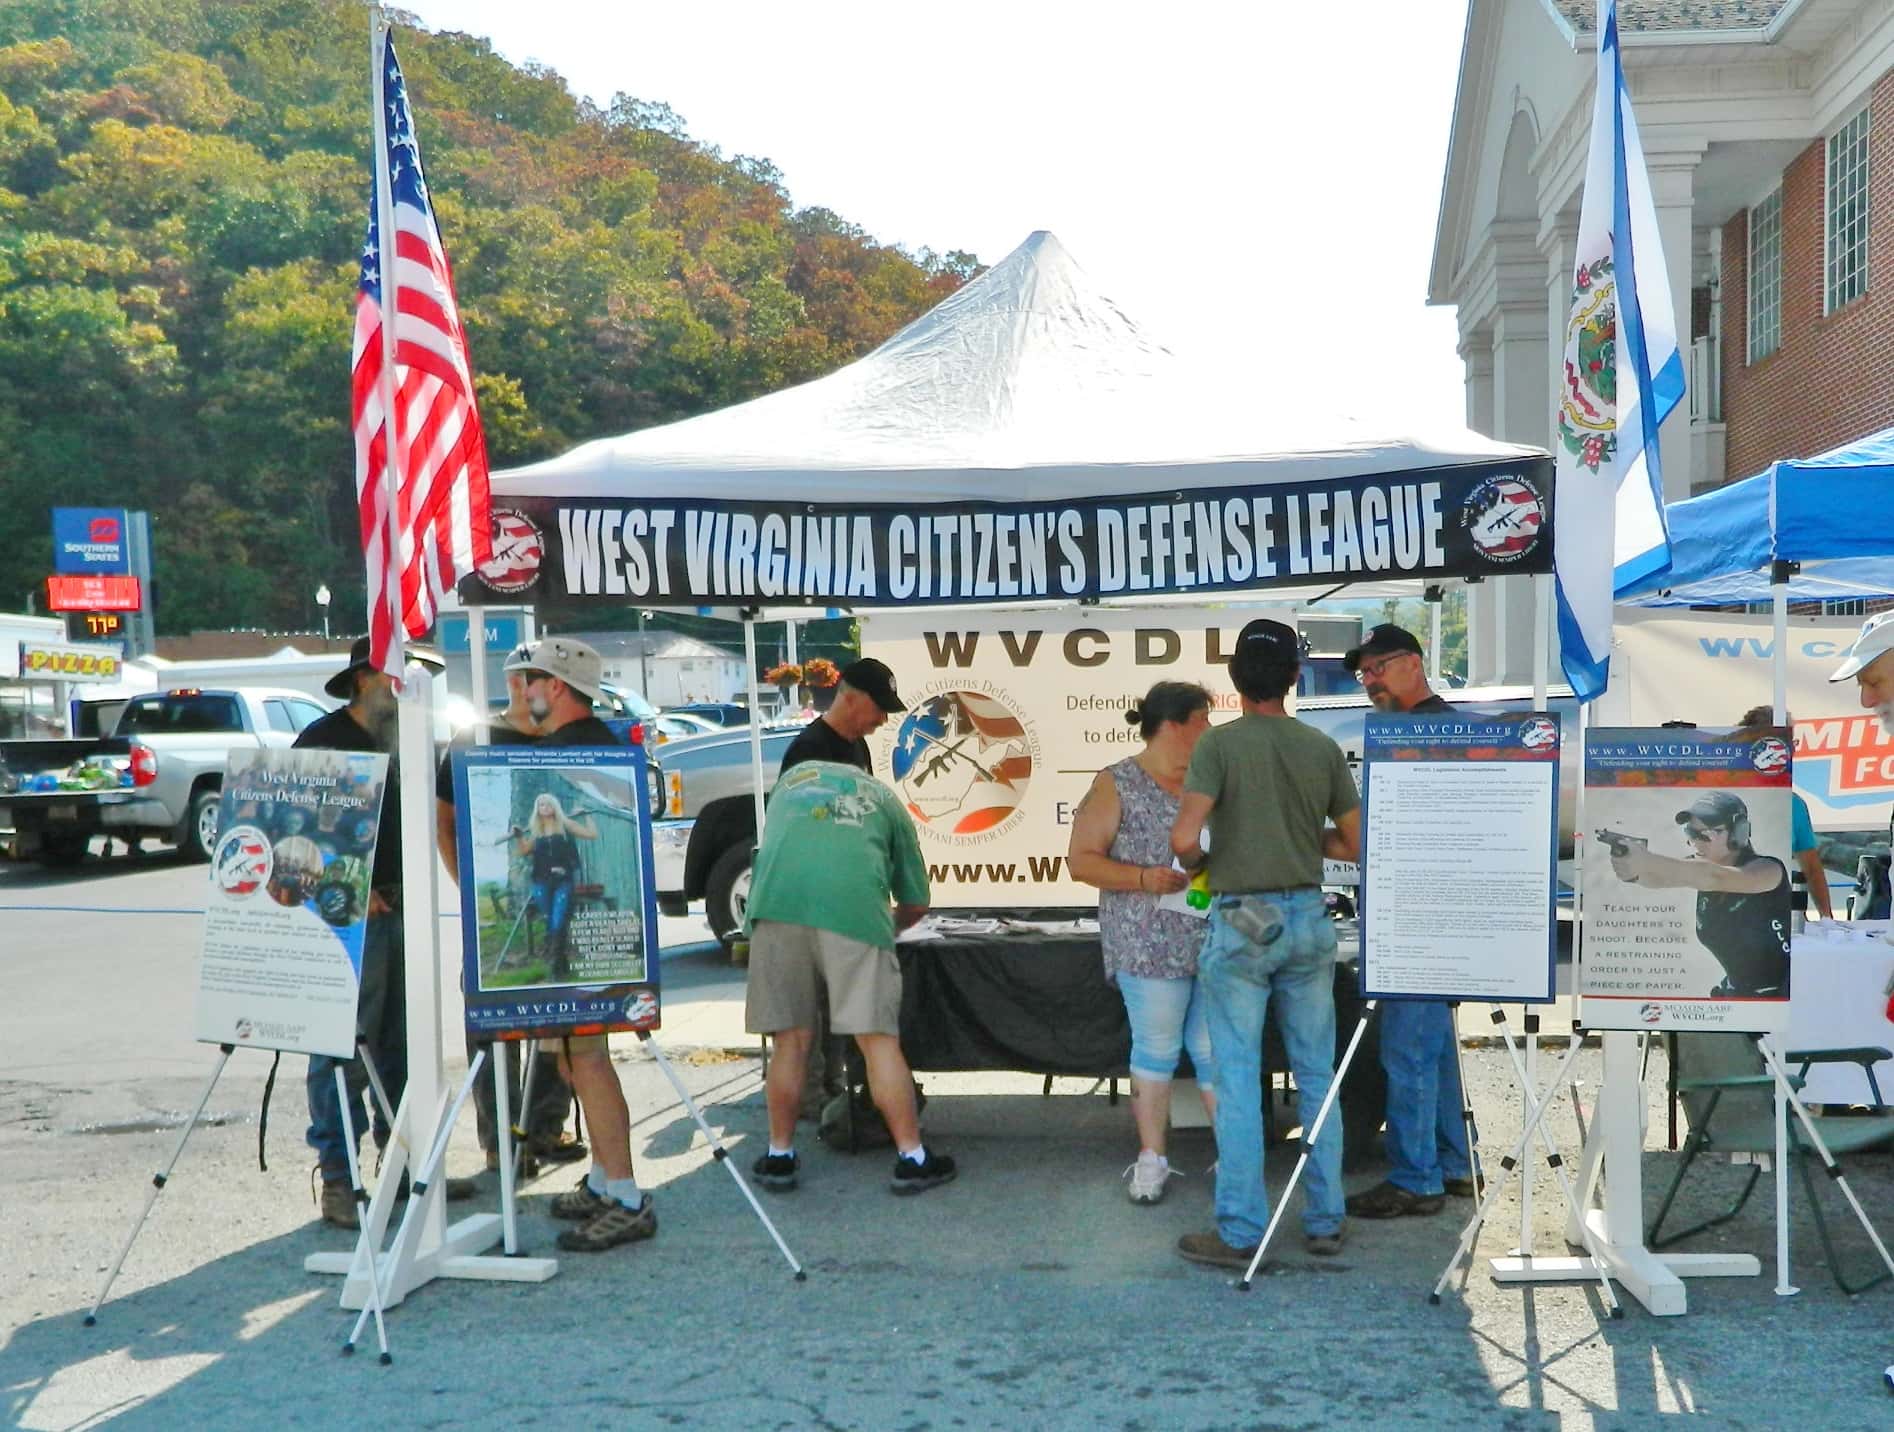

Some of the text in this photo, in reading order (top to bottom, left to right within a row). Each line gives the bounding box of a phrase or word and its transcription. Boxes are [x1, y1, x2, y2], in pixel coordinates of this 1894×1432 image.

[558, 508, 675, 597] WEST
[684, 510, 877, 599] VIRGINIA
[887, 507, 1087, 600] CITIZEN'S
[1097, 496, 1277, 592] DEFENSE
[1286, 482, 1445, 575] LEAGUE
[30, 650, 117, 677] PIZZA
[925, 677, 978, 693] Citizens
[981, 679, 1027, 718] Defense
[1084, 729, 1101, 743] to
[263, 771, 337, 788] West Virginia
[232, 789, 366, 808] Citizens Defense League
[954, 830, 998, 847] SEMPER
[929, 856, 1072, 883] www.W
[1602, 904, 1640, 912] TEACH
[1596, 920, 1663, 928] DAUGHTERS
[1635, 936, 1688, 944] BECAUSE
[1606, 951, 1681, 959] RESTRAINING
[1590, 981, 1622, 989] PIECE
